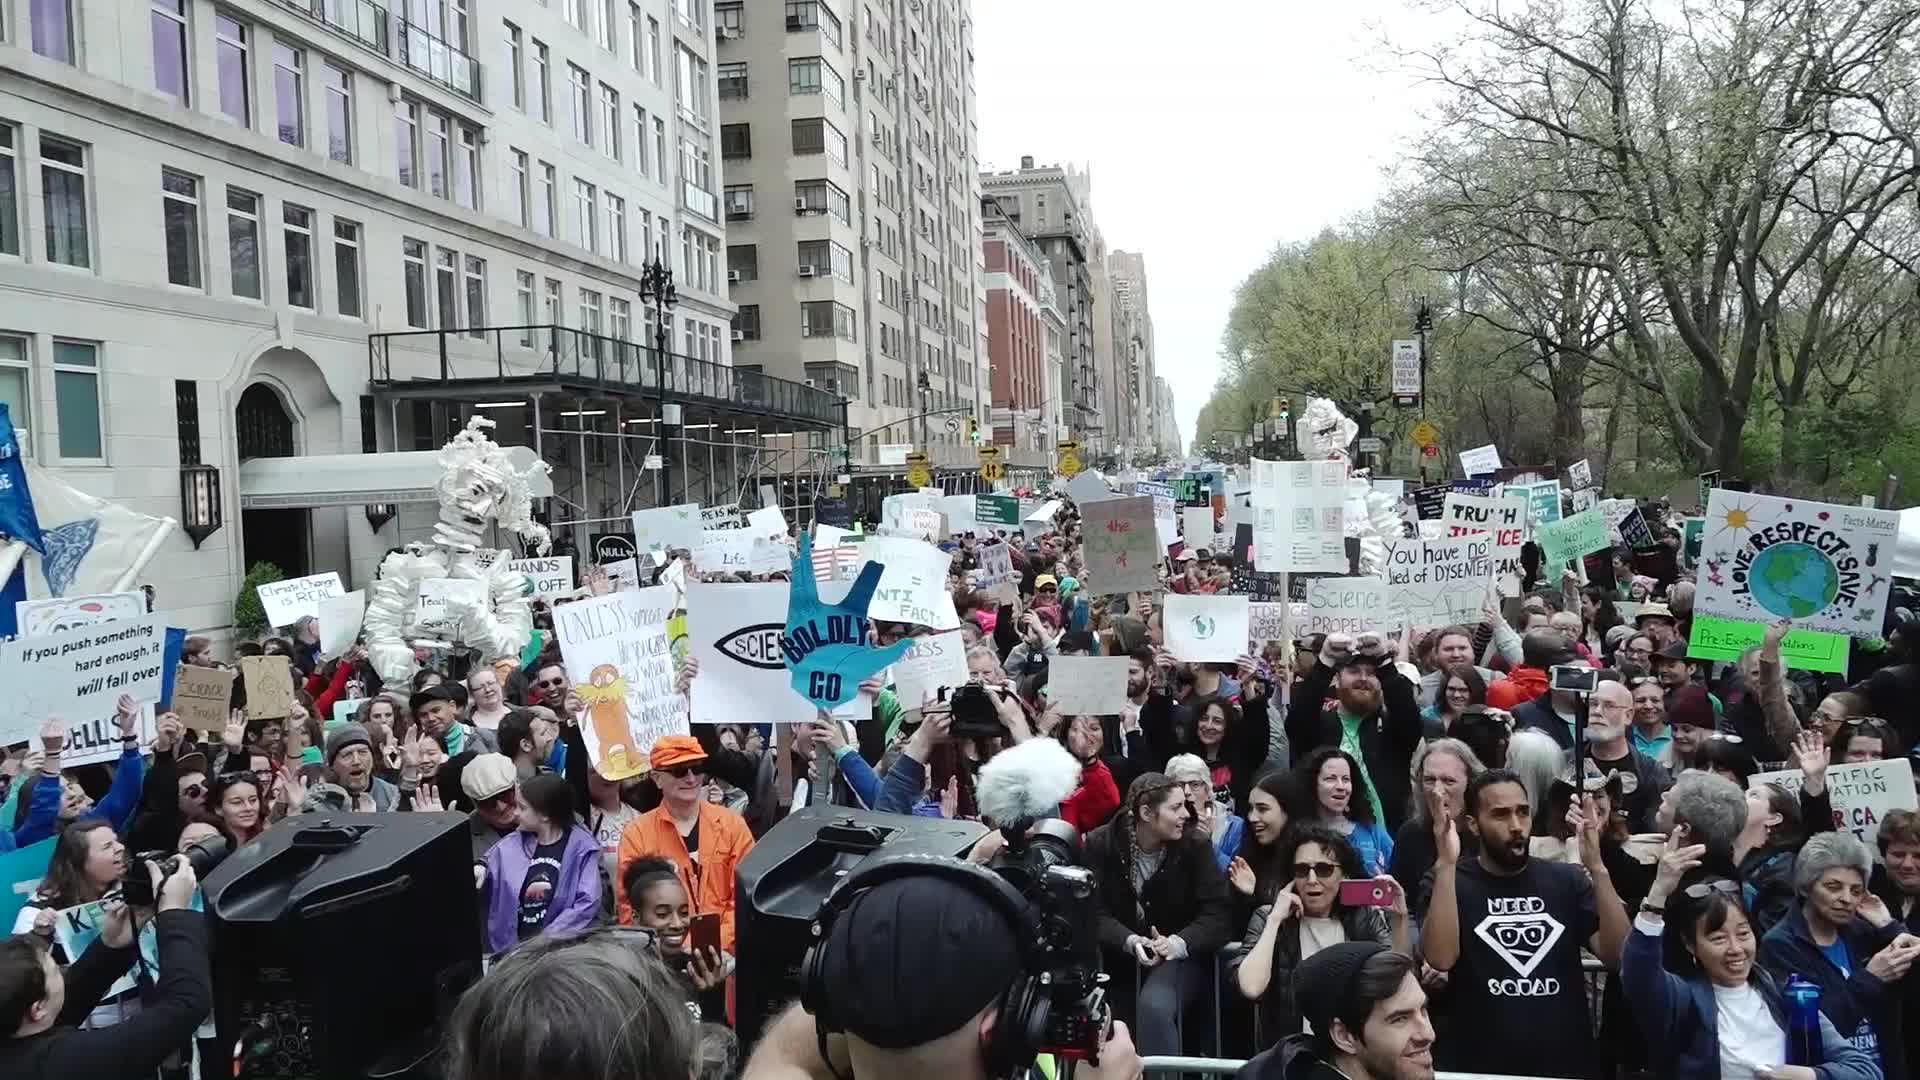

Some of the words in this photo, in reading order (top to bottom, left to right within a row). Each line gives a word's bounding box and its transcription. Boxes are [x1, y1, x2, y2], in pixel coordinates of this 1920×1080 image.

[1452, 504, 1517, 524] TRUH
[1382, 541, 1417, 566] You
[1423, 541, 1459, 564] have
[1468, 539, 1488, 560] no
[508, 559, 560, 574] HANDS
[1732, 549, 1754, 595] LOVE
[1749, 521, 1851, 558] RESPECT
[1833, 557, 1861, 608] SAVE
[538, 578, 567, 592] OFF
[1414, 567, 1428, 583] of
[260, 582, 299, 598] Climate
[295, 590, 336, 604] REAL
[22, 649, 33, 663] If
[35, 645, 59, 662] you
[62, 638, 92, 656] push
[95, 625, 154, 647] something
[779, 614, 869, 665] BOLDLY
[75, 655, 103, 672] hard
[105, 646, 150, 664] enough,
[152, 642, 160, 653] it
[76, 677, 104, 697] will
[106, 671, 129, 689] fall
[132, 666, 161, 682] over
[808, 670, 842, 702] GO
[1487, 896, 1546, 915] NERD
[1487, 977, 1560, 996] SQUAD
